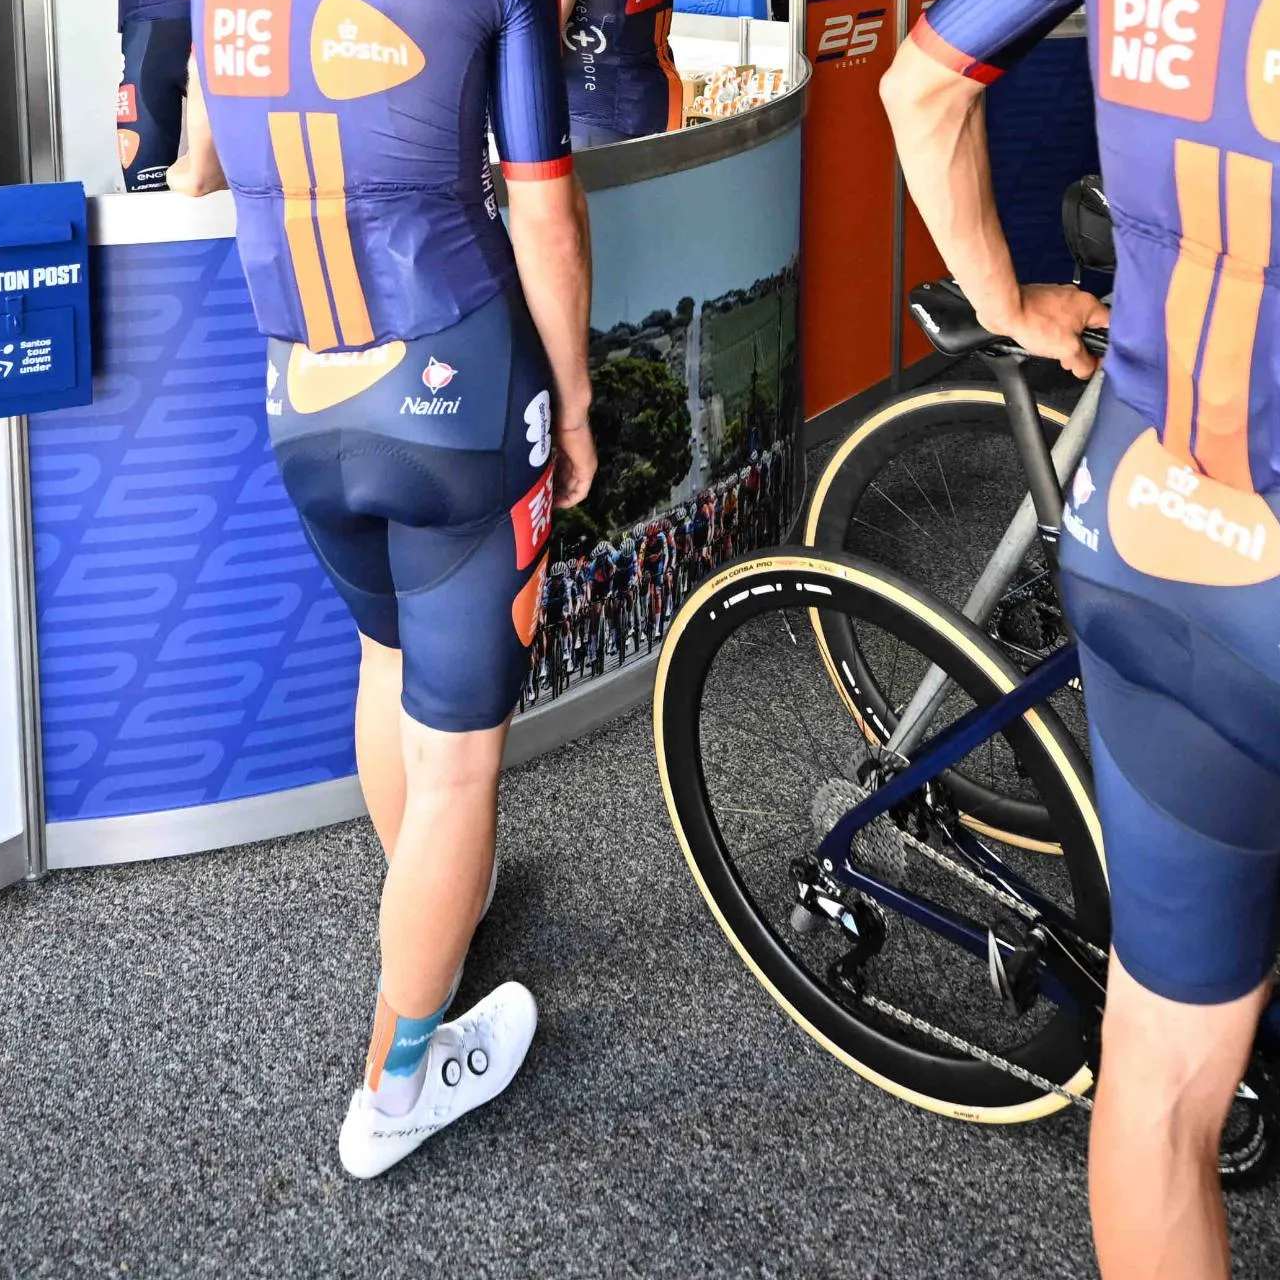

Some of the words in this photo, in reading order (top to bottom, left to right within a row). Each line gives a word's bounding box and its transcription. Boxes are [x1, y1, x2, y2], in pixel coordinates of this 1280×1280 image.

[213, 7, 272, 35] PIC
[818, 15, 883, 57] 25
[322, 38, 408, 67] postnl
[582, 53, 596, 91] more
[836, 57, 867, 69] YEARS
[33, 264, 80, 289] POST
[20, 338, 51, 349] Santos
[27, 347, 50, 357] tour
[20, 363, 52, 374] under
[22, 354, 51, 365] down
[400, 396, 462, 416] Nalini
[1128, 474, 1266, 562] postnl
[729, 565, 754, 578] CORSA
[756, 560, 773, 568] PRO
